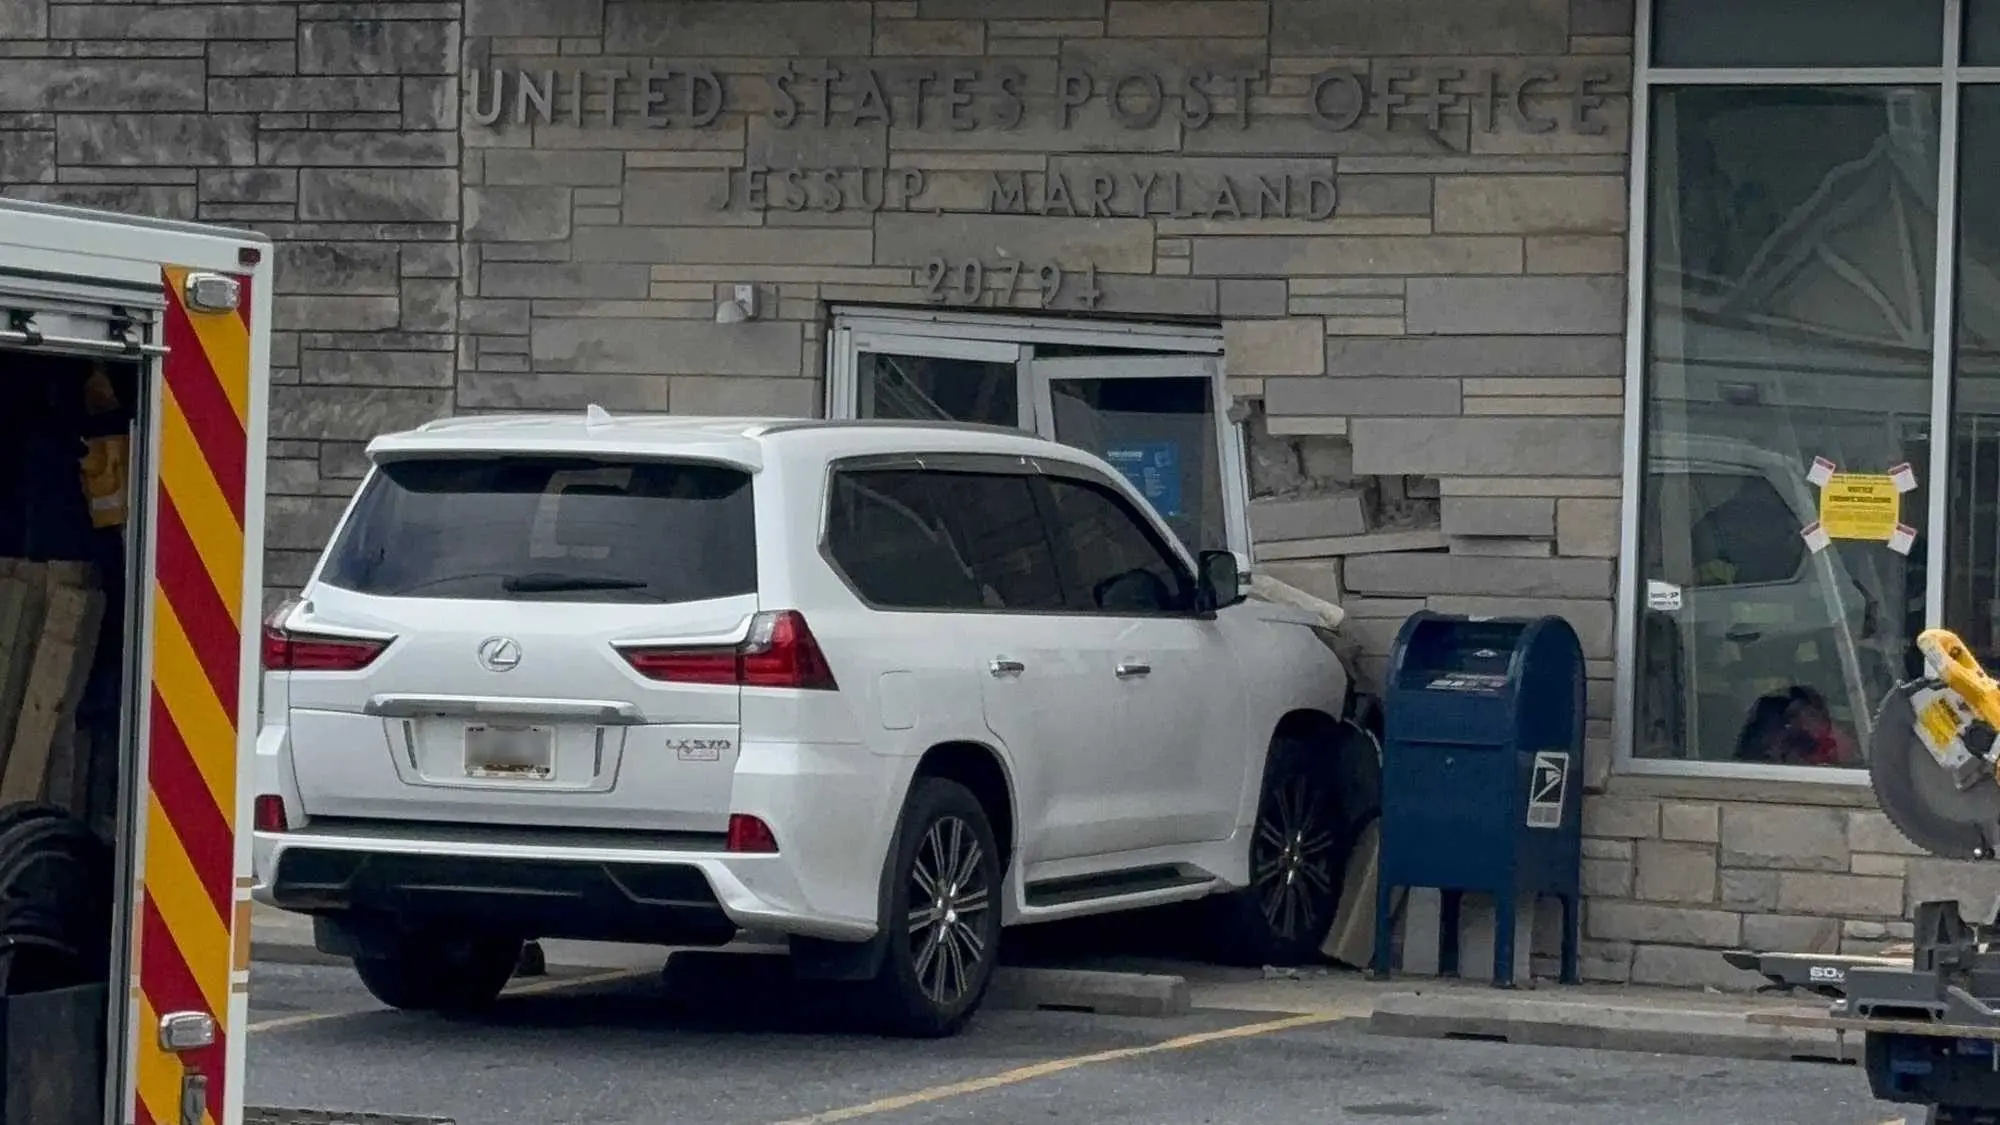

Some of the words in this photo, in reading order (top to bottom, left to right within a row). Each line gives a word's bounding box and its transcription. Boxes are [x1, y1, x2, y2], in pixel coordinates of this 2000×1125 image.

[470, 67, 723, 129] UNITED
[767, 66, 1028, 131] STATES
[1057, 67, 1267, 131] POST
[1310, 66, 1612, 135] OFFICE
[988, 171, 1339, 221] MARYLAND
